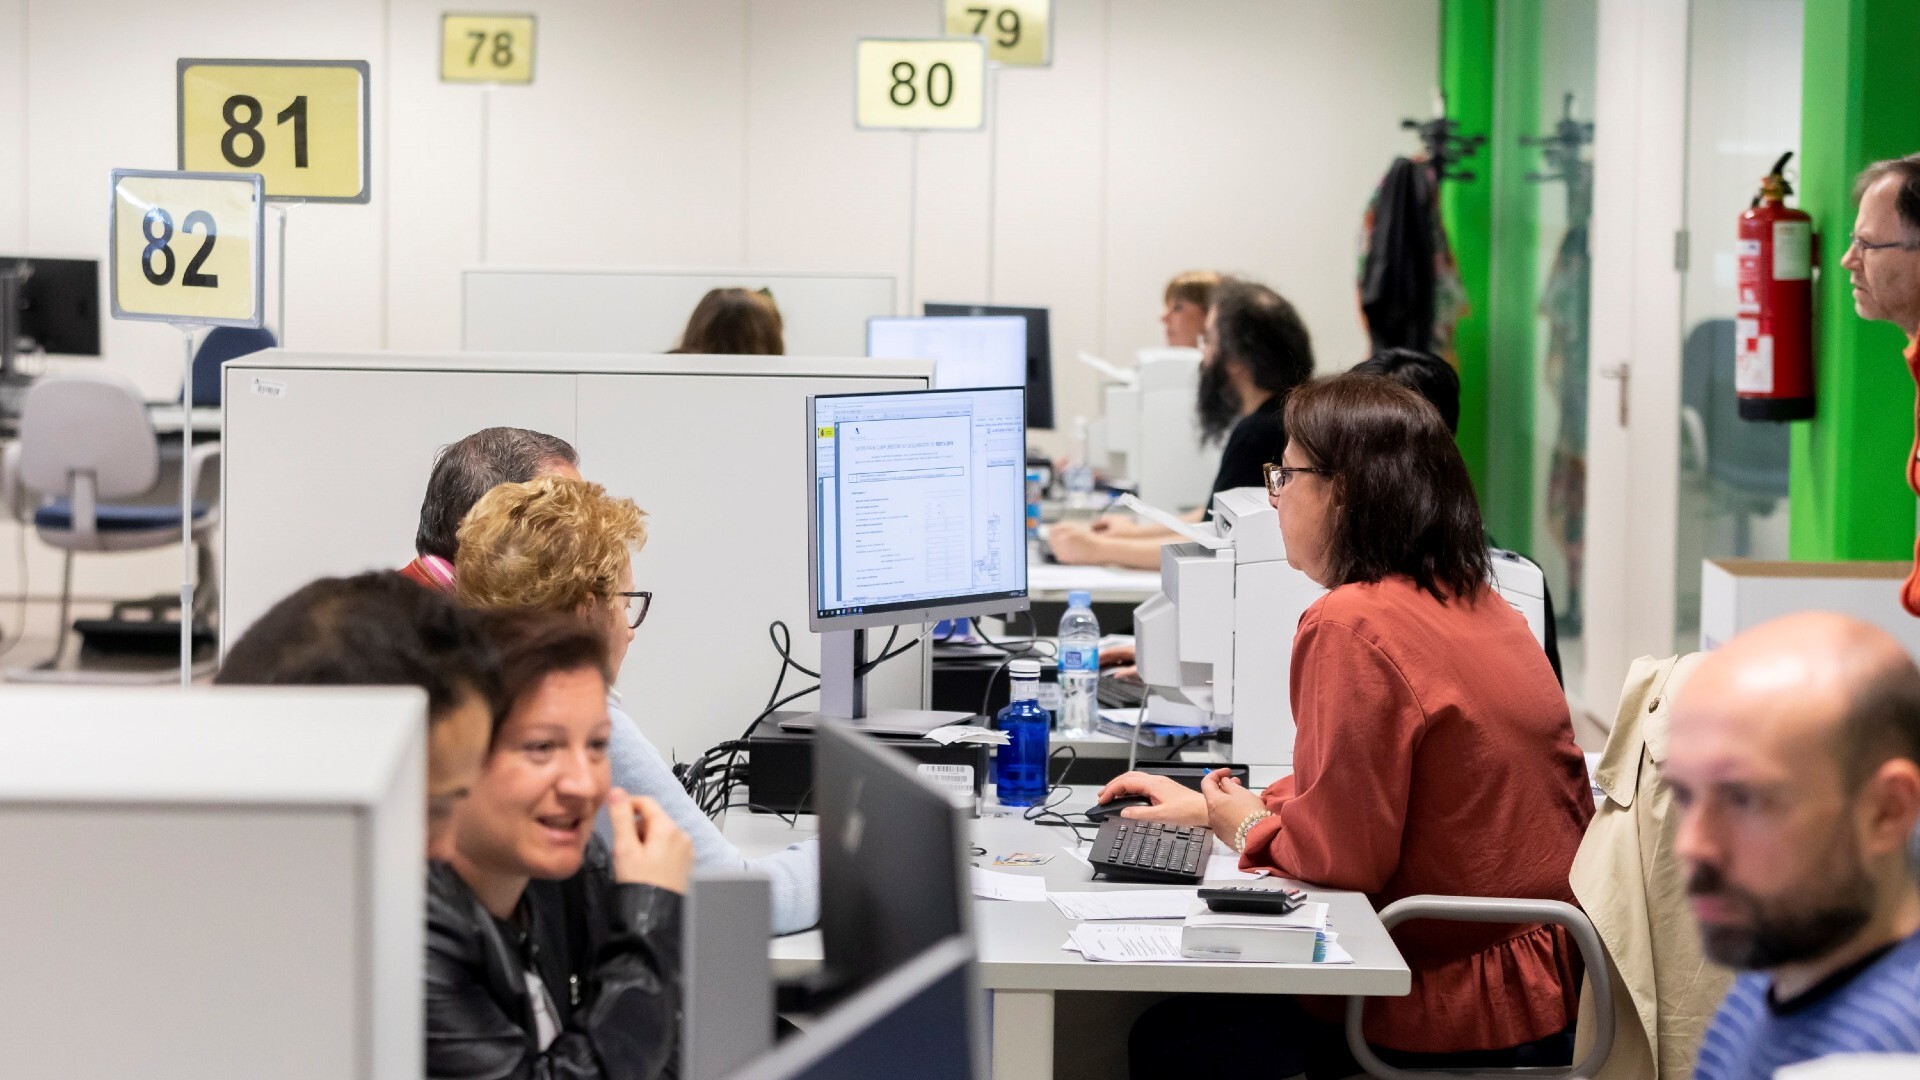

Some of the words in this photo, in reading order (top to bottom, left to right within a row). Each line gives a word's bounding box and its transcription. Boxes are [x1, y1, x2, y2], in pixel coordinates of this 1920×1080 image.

[468, 31, 514, 67] 78
[966, 8, 1021, 48] 79
[890, 61, 954, 107] 80
[220, 94, 309, 169] 81
[141, 209, 219, 289] 82
